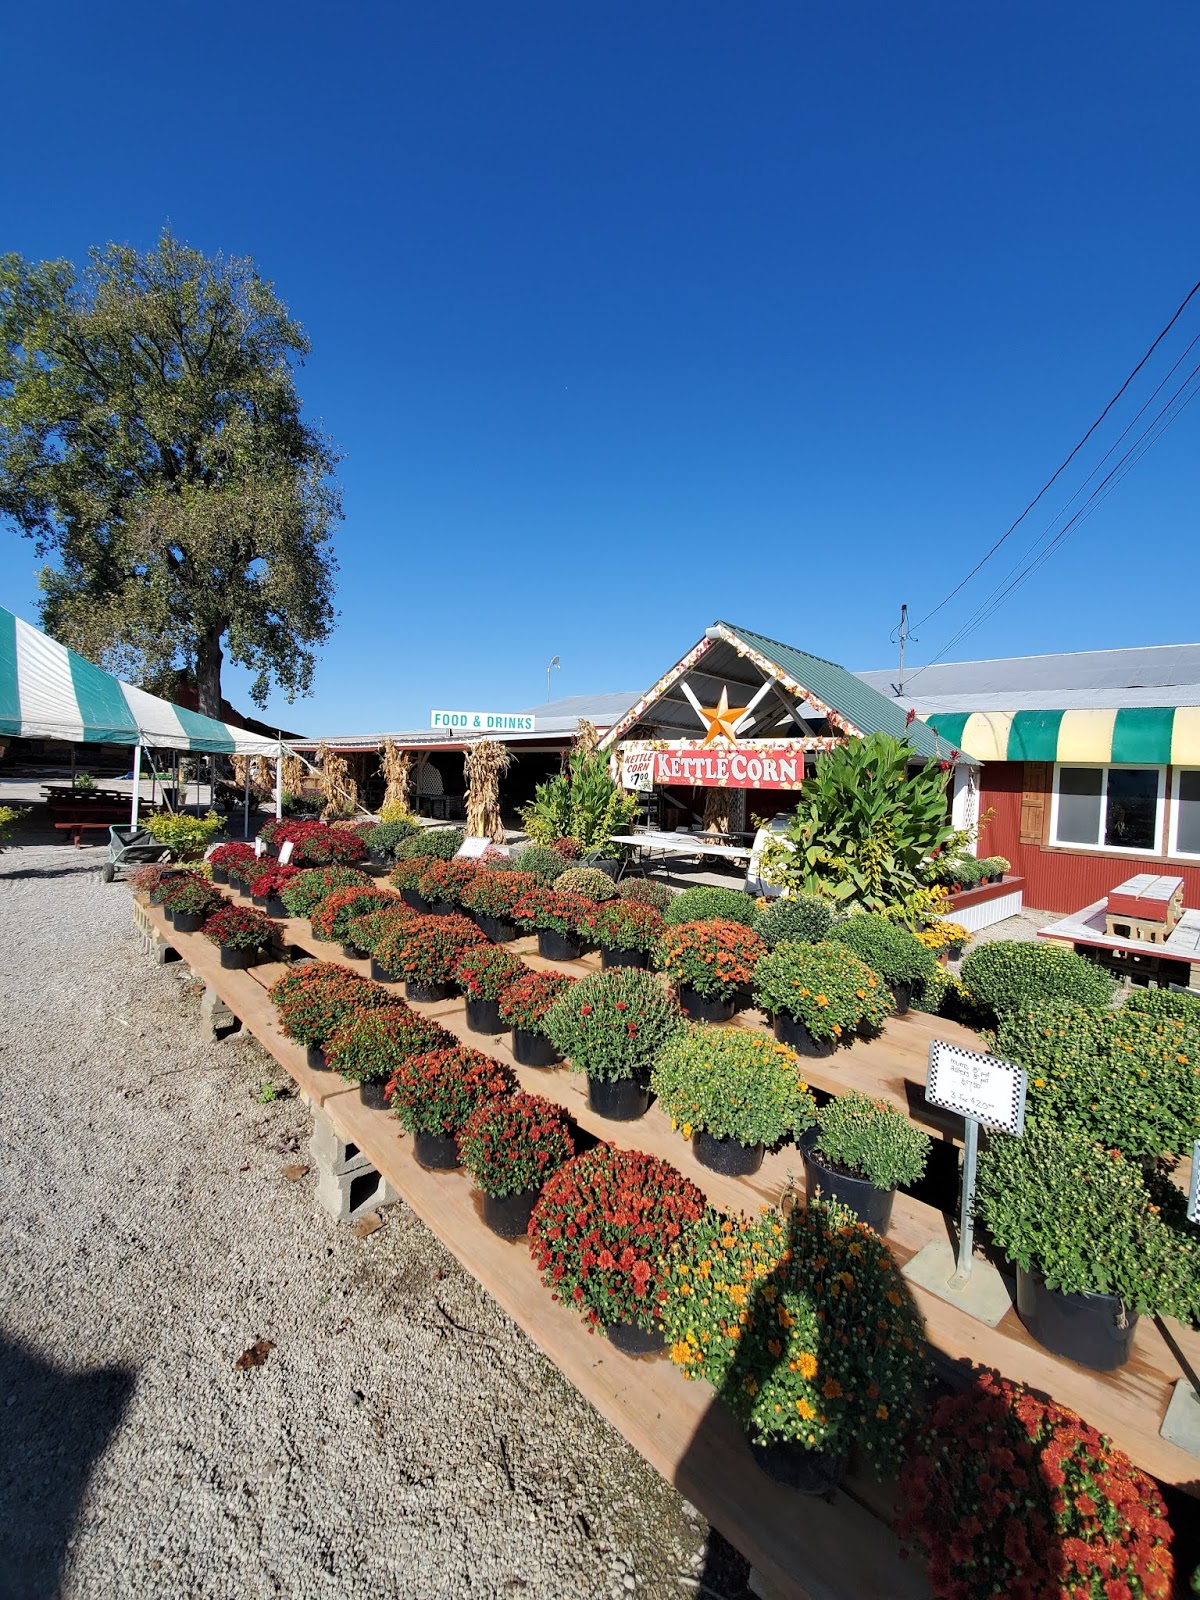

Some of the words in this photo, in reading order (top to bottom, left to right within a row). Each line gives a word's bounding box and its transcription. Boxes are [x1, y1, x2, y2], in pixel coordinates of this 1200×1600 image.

[435, 713, 467, 726] FOOD
[473, 715, 481, 727] &
[487, 716, 532, 729] DRINKS
[625, 753, 653, 764] KETTLE
[627, 763, 650, 773] CORN
[950, 1090, 956, 1099] 3
